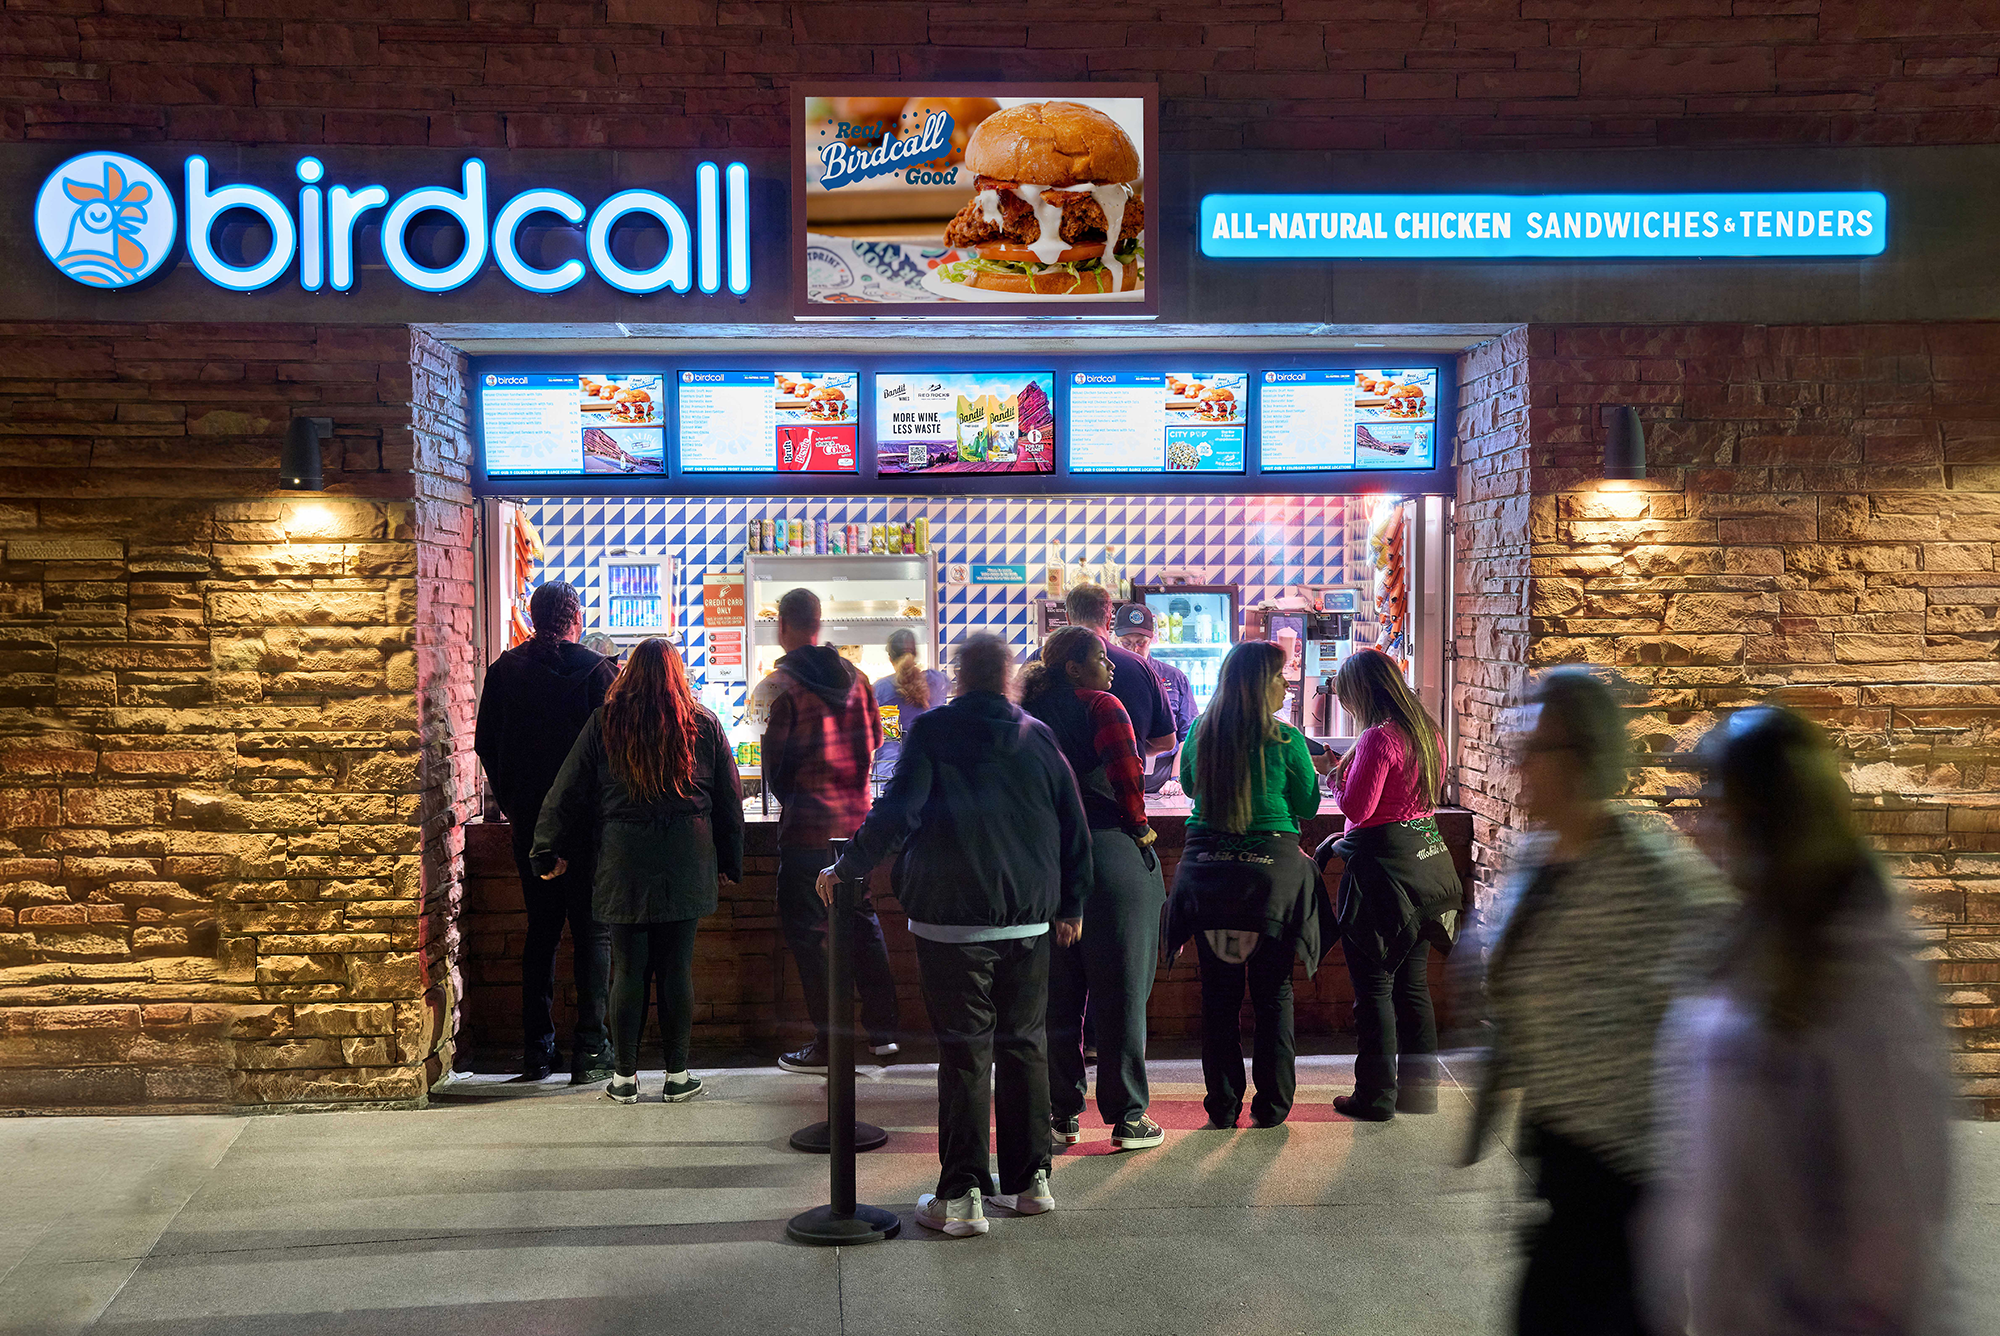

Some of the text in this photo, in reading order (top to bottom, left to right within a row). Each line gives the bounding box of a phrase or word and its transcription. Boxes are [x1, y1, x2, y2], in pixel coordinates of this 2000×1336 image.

[835, 120, 883, 139] Real
[820, 110, 951, 186] Birdcall
[905, 166, 959, 185] Good
[186, 155, 749, 294] birdcall
[1212, 210, 1873, 239] ALL-NATURAL CHICKEN SANDWICHES & TENDERS
[498, 376, 529, 385] birdcall
[694, 373, 725, 382] birdcall
[1086, 374, 1117, 383] birdcall
[1277, 372, 1306, 381] birdcall
[883, 383, 906, 399] Bandit
[893, 412, 941, 423] MORE WINE,
[959, 406, 985, 425] Bandit
[989, 406, 1015, 424] Bandit
[893, 423, 941, 434] LESS WASTE
[822, 443, 852, 456] Coke
[705, 598, 744, 607] CREDIT CARD
[717, 606, 732, 615] ONLY
[1196, 851, 1275, 865] Mobile Clinic
